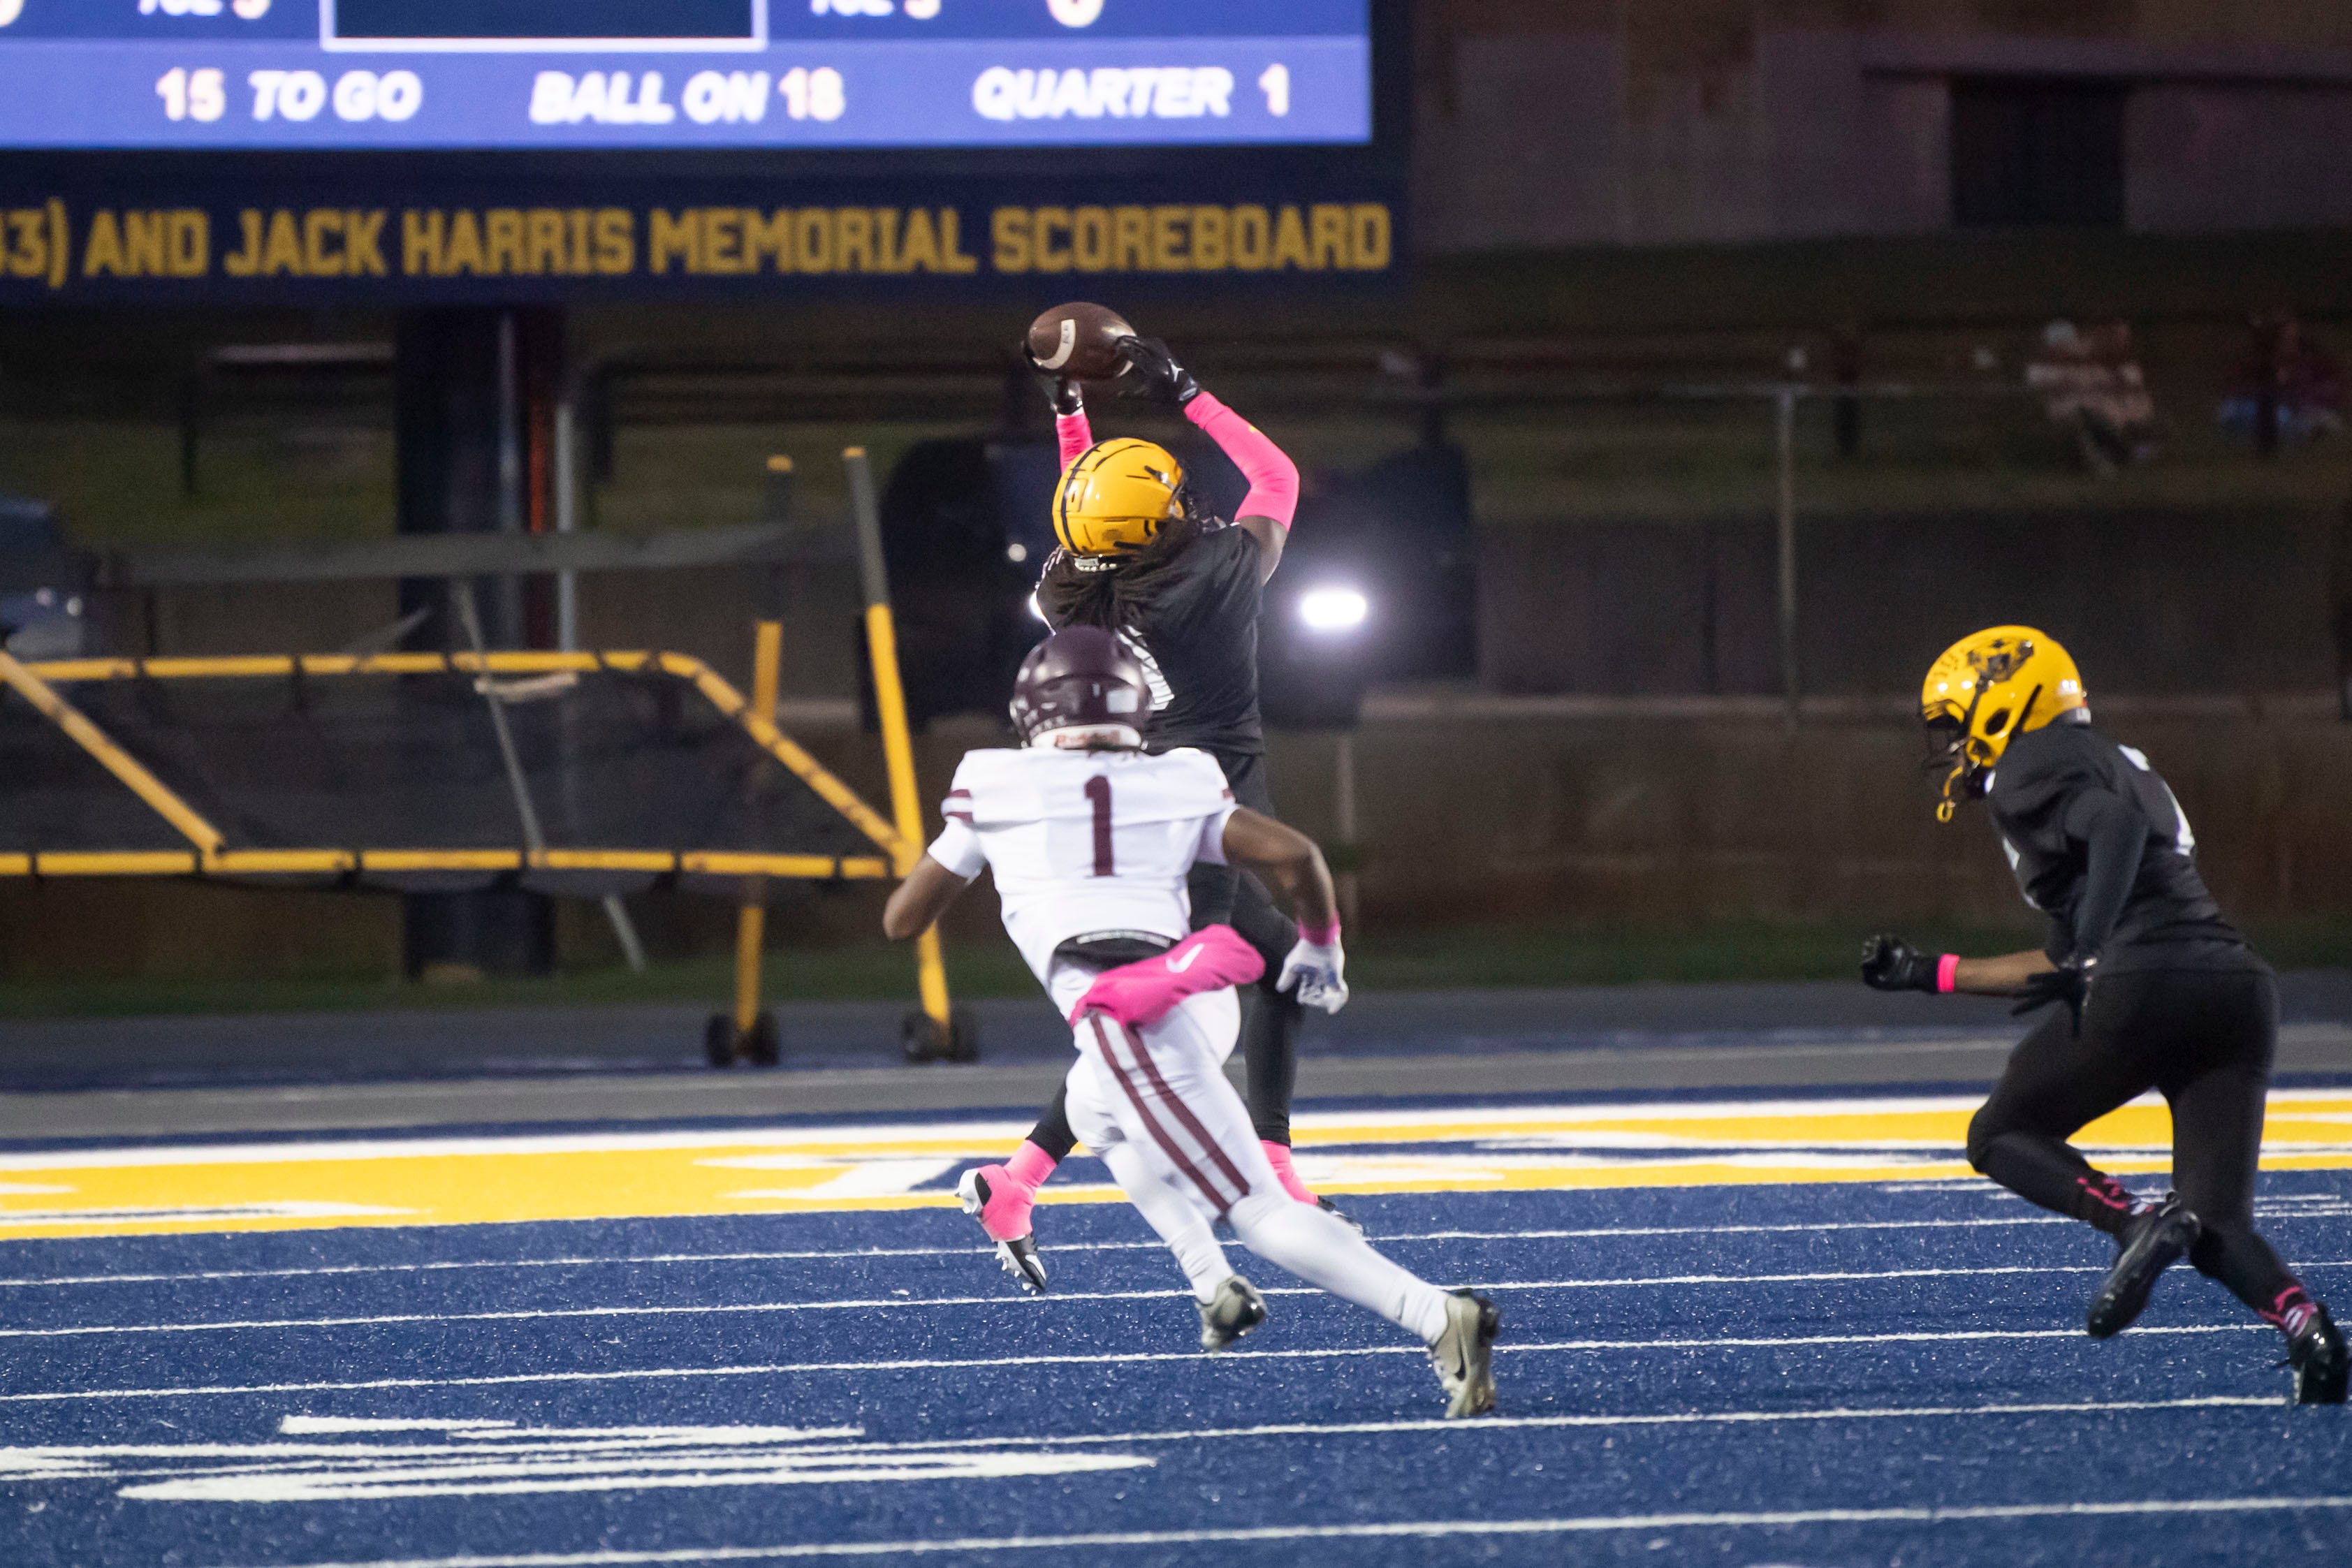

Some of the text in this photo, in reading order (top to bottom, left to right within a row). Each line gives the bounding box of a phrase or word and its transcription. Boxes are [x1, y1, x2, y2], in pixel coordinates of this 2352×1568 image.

[156, 66, 423, 122] 15 TO GO
[529, 70, 676, 124] BALL
[682, 70, 770, 124] ON
[972, 64, 1290, 121] QUARTER 1
[0, 196, 1393, 289] 3) AND JACK HARRIS MEMORIAL SCOREBOARD
[1084, 775, 1114, 877] 1
